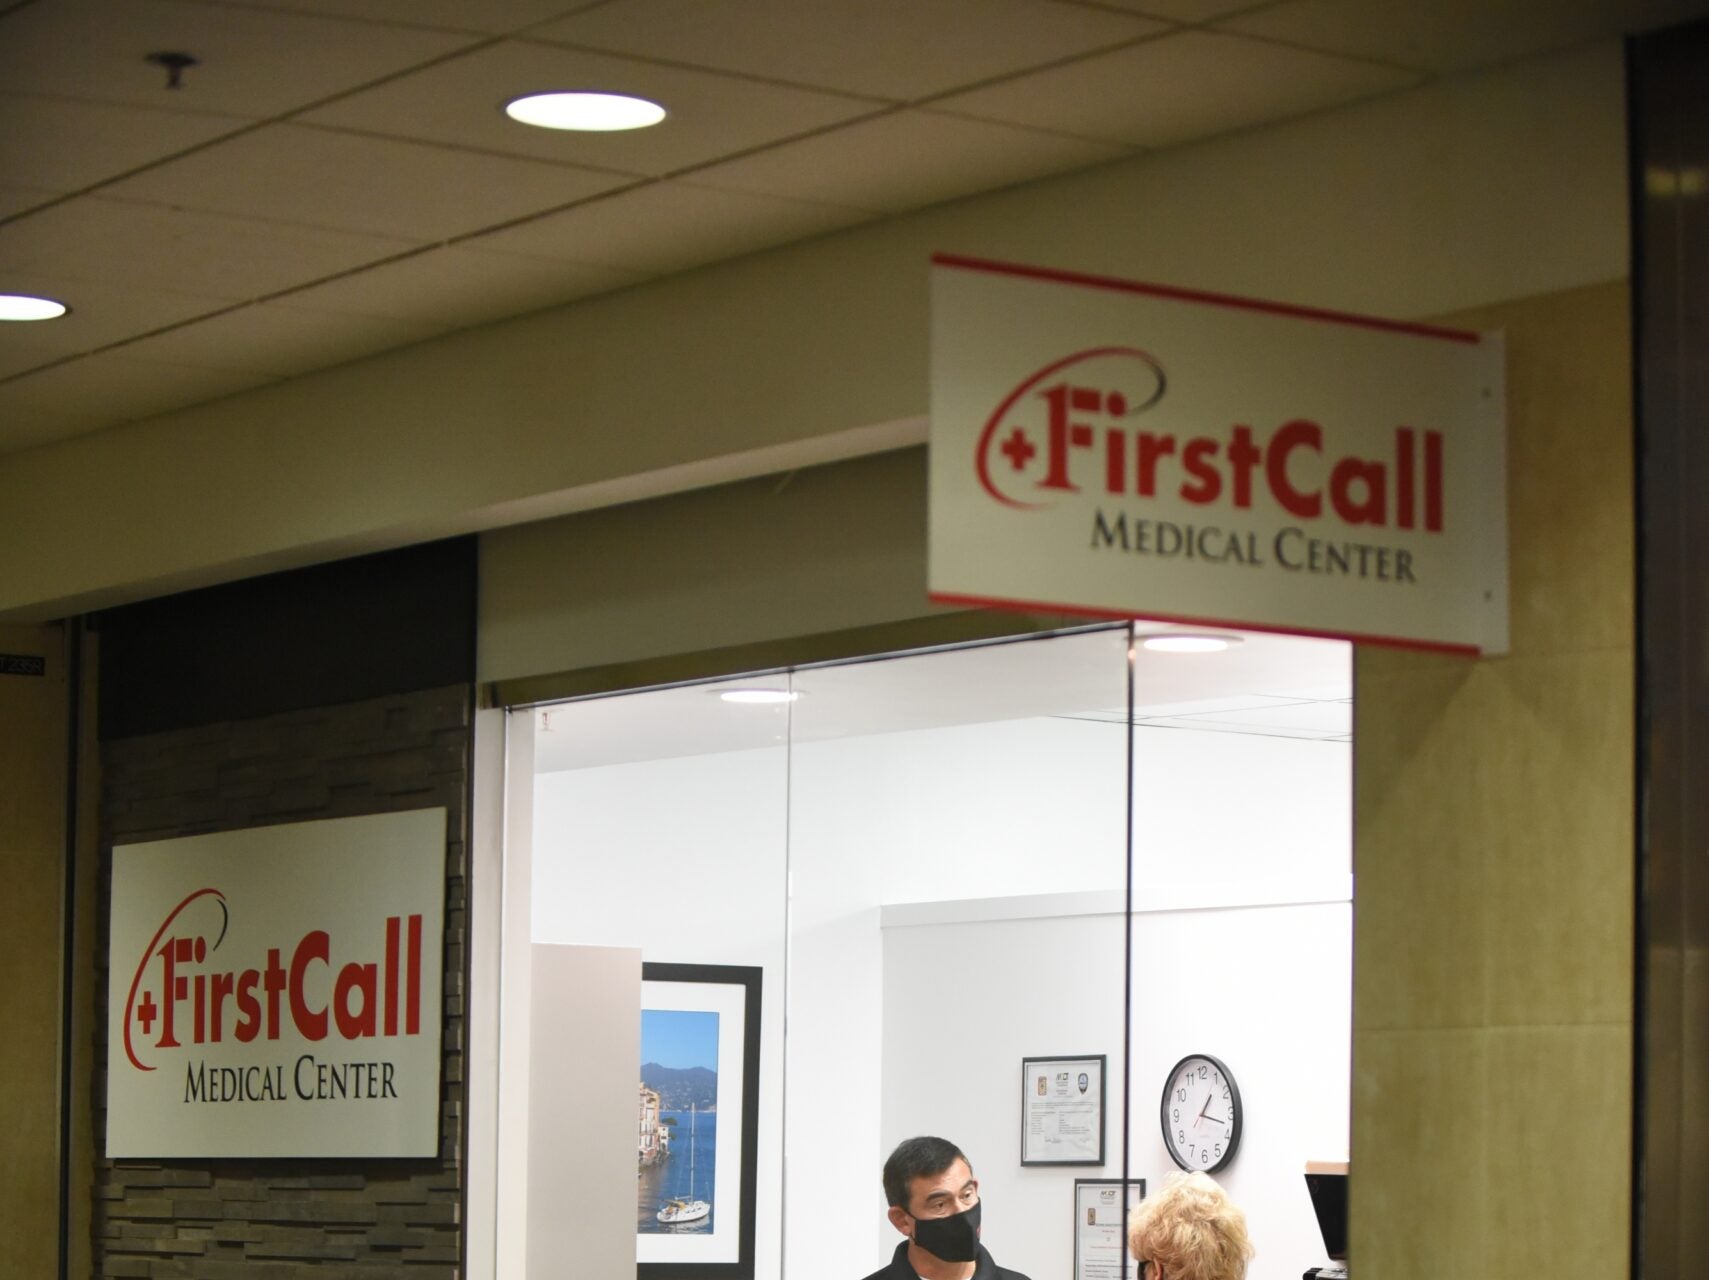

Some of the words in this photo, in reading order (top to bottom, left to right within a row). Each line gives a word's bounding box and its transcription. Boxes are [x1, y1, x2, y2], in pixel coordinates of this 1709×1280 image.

[1035, 382, 1443, 533] FirstCall
[1090, 508, 1265, 569] MEDICAL
[1274, 528, 1417, 584] CENTER
[155, 914, 423, 1049] FirstCall
[183, 1060, 287, 1104] MEDICAL
[294, 1055, 398, 1101] CENTER
[1186, 1072, 1194, 1086] 11
[1197, 1065, 1208, 1080] 12
[1214, 1071, 1218, 1085] 1
[1176, 1088, 1187, 1103] 10
[1222, 1085, 1231, 1100] 2
[1173, 1108, 1180, 1123] 9
[1228, 1106, 1234, 1121] 3
[1179, 1130, 1185, 1144] 8
[1224, 1128, 1231, 1140] 4
[1189, 1144, 1195, 1158] 7
[1201, 1149, 1209, 1164] 6
[1214, 1143, 1222, 1158] 5
